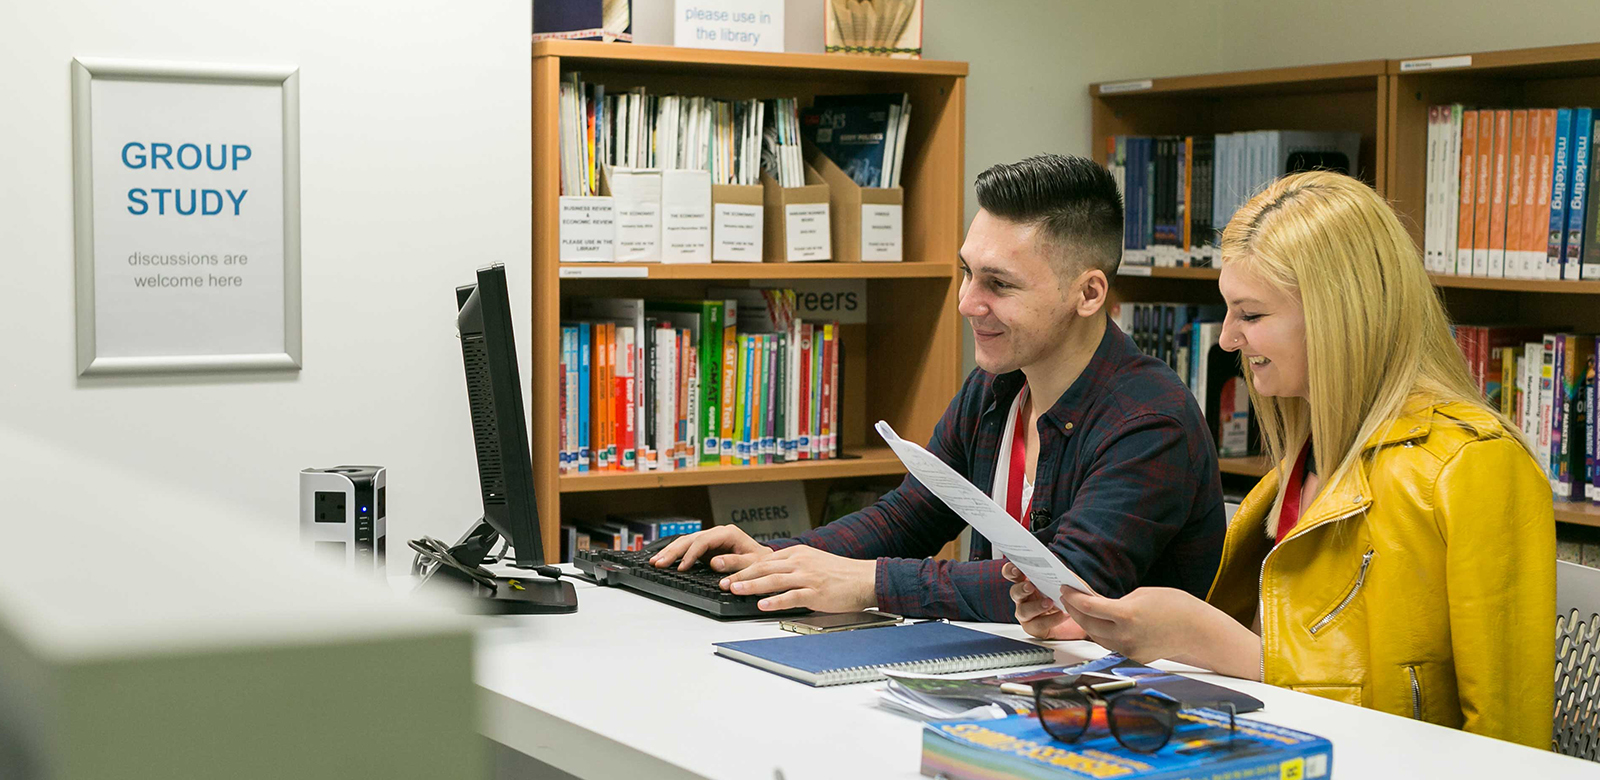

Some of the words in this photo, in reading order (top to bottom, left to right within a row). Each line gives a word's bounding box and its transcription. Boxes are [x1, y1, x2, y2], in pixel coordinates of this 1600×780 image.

[686, 8, 728, 22] please
[733, 12, 756, 23] use
[760, 12, 771, 24] in
[697, 28, 716, 40] the
[721, 28, 760, 46] library
[121, 142, 252, 170] GROUP
[1552, 137, 1567, 210] marketing
[1571, 136, 1588, 210] marketing
[127, 188, 248, 216] STUDY
[128, 252, 218, 266] discussions
[224, 254, 248, 265] are
[134, 274, 204, 287] welcome
[209, 274, 242, 286] here
[796, 291, 858, 311] reers
[708, 362, 718, 404] GMAT
[724, 370, 733, 404] Practice
[724, 406, 732, 428] Tests
[1564, 402, 1570, 413] OF
[1542, 404, 1551, 446] Marketing
[1562, 414, 1570, 454] MARKETING
[732, 505, 789, 523] CAREERS
